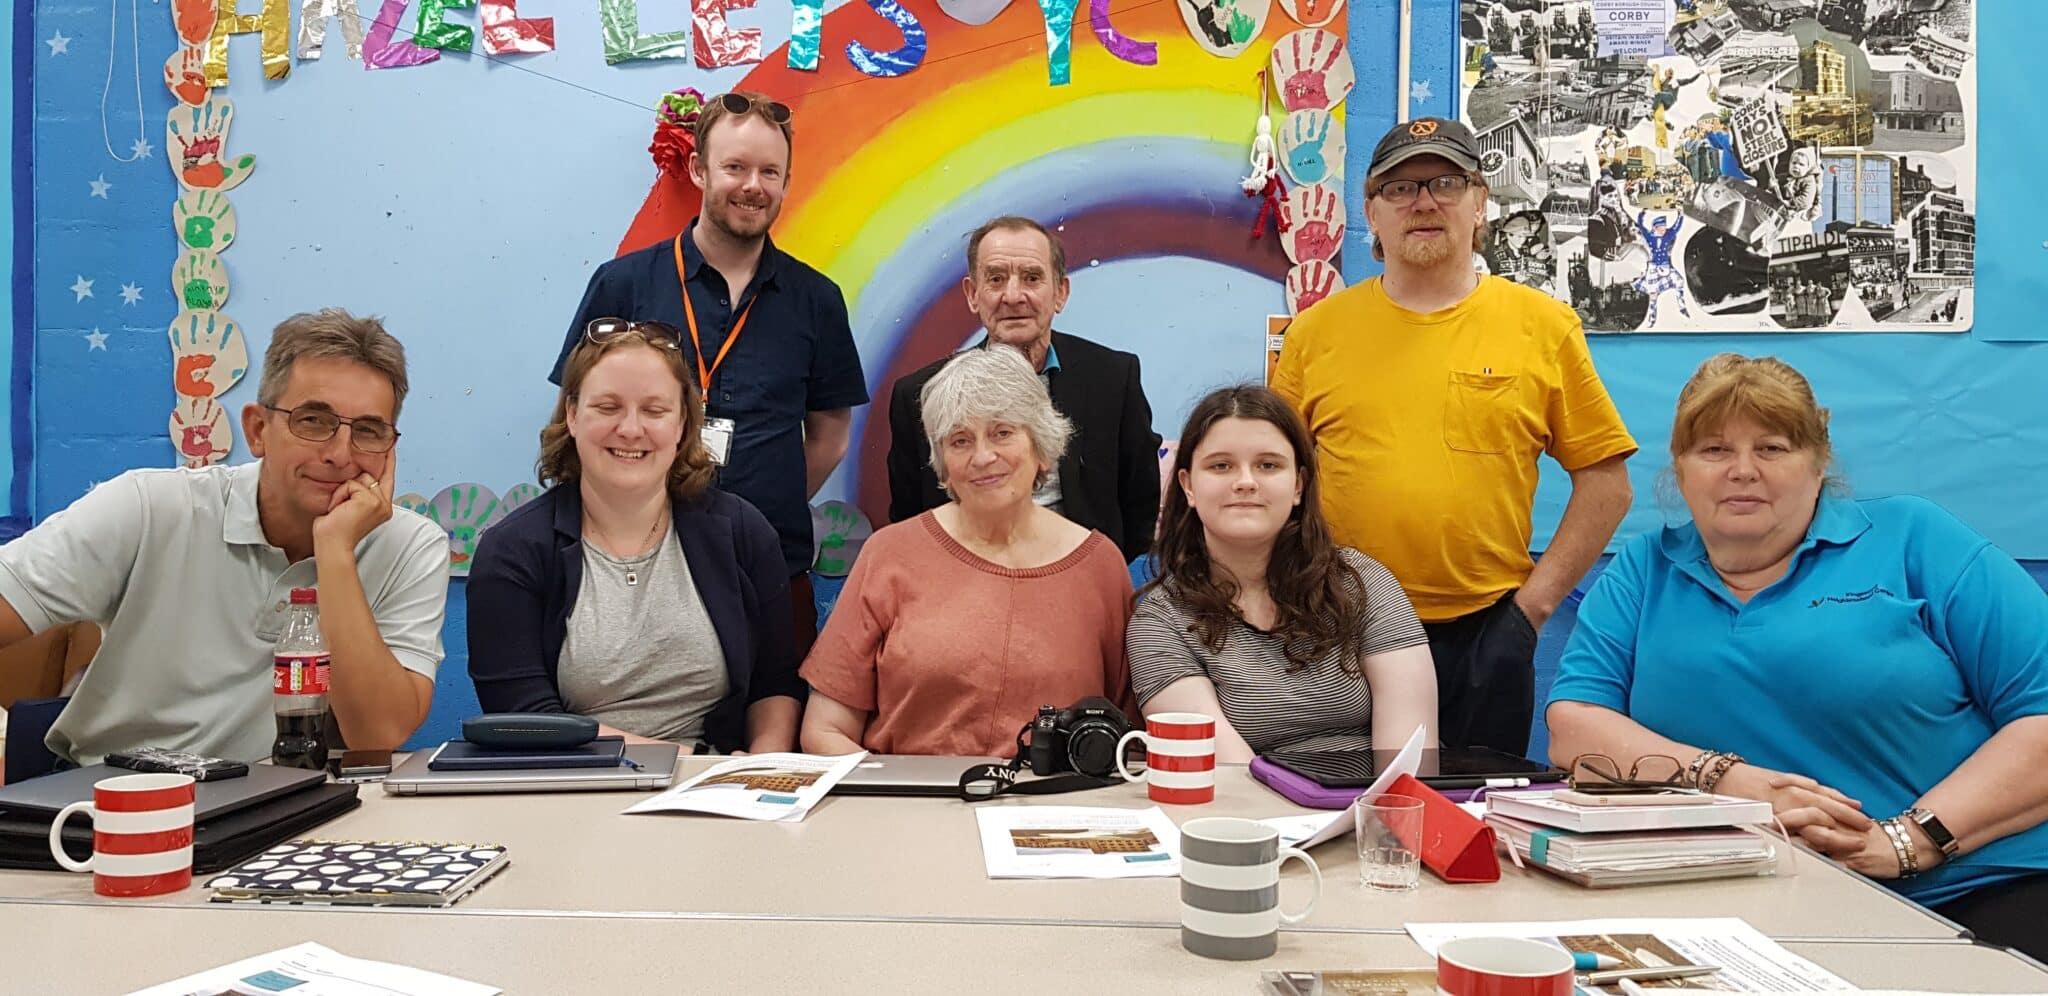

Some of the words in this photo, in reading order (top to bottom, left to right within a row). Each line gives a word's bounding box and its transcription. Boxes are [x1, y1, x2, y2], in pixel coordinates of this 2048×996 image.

[1608, 11, 1650, 21] CORBY
[1734, 94, 1766, 121] CORBY
[1737, 105, 1767, 130] SAYS
[1740, 111, 1777, 145] NO!
[1742, 137, 1786, 165] CLOSURE
[1744, 130, 1778, 154] STEEL
[1846, 172, 1878, 181] CRBY
[1778, 229, 1841, 254] TIPALDI
[984, 766, 1016, 783] ONY
